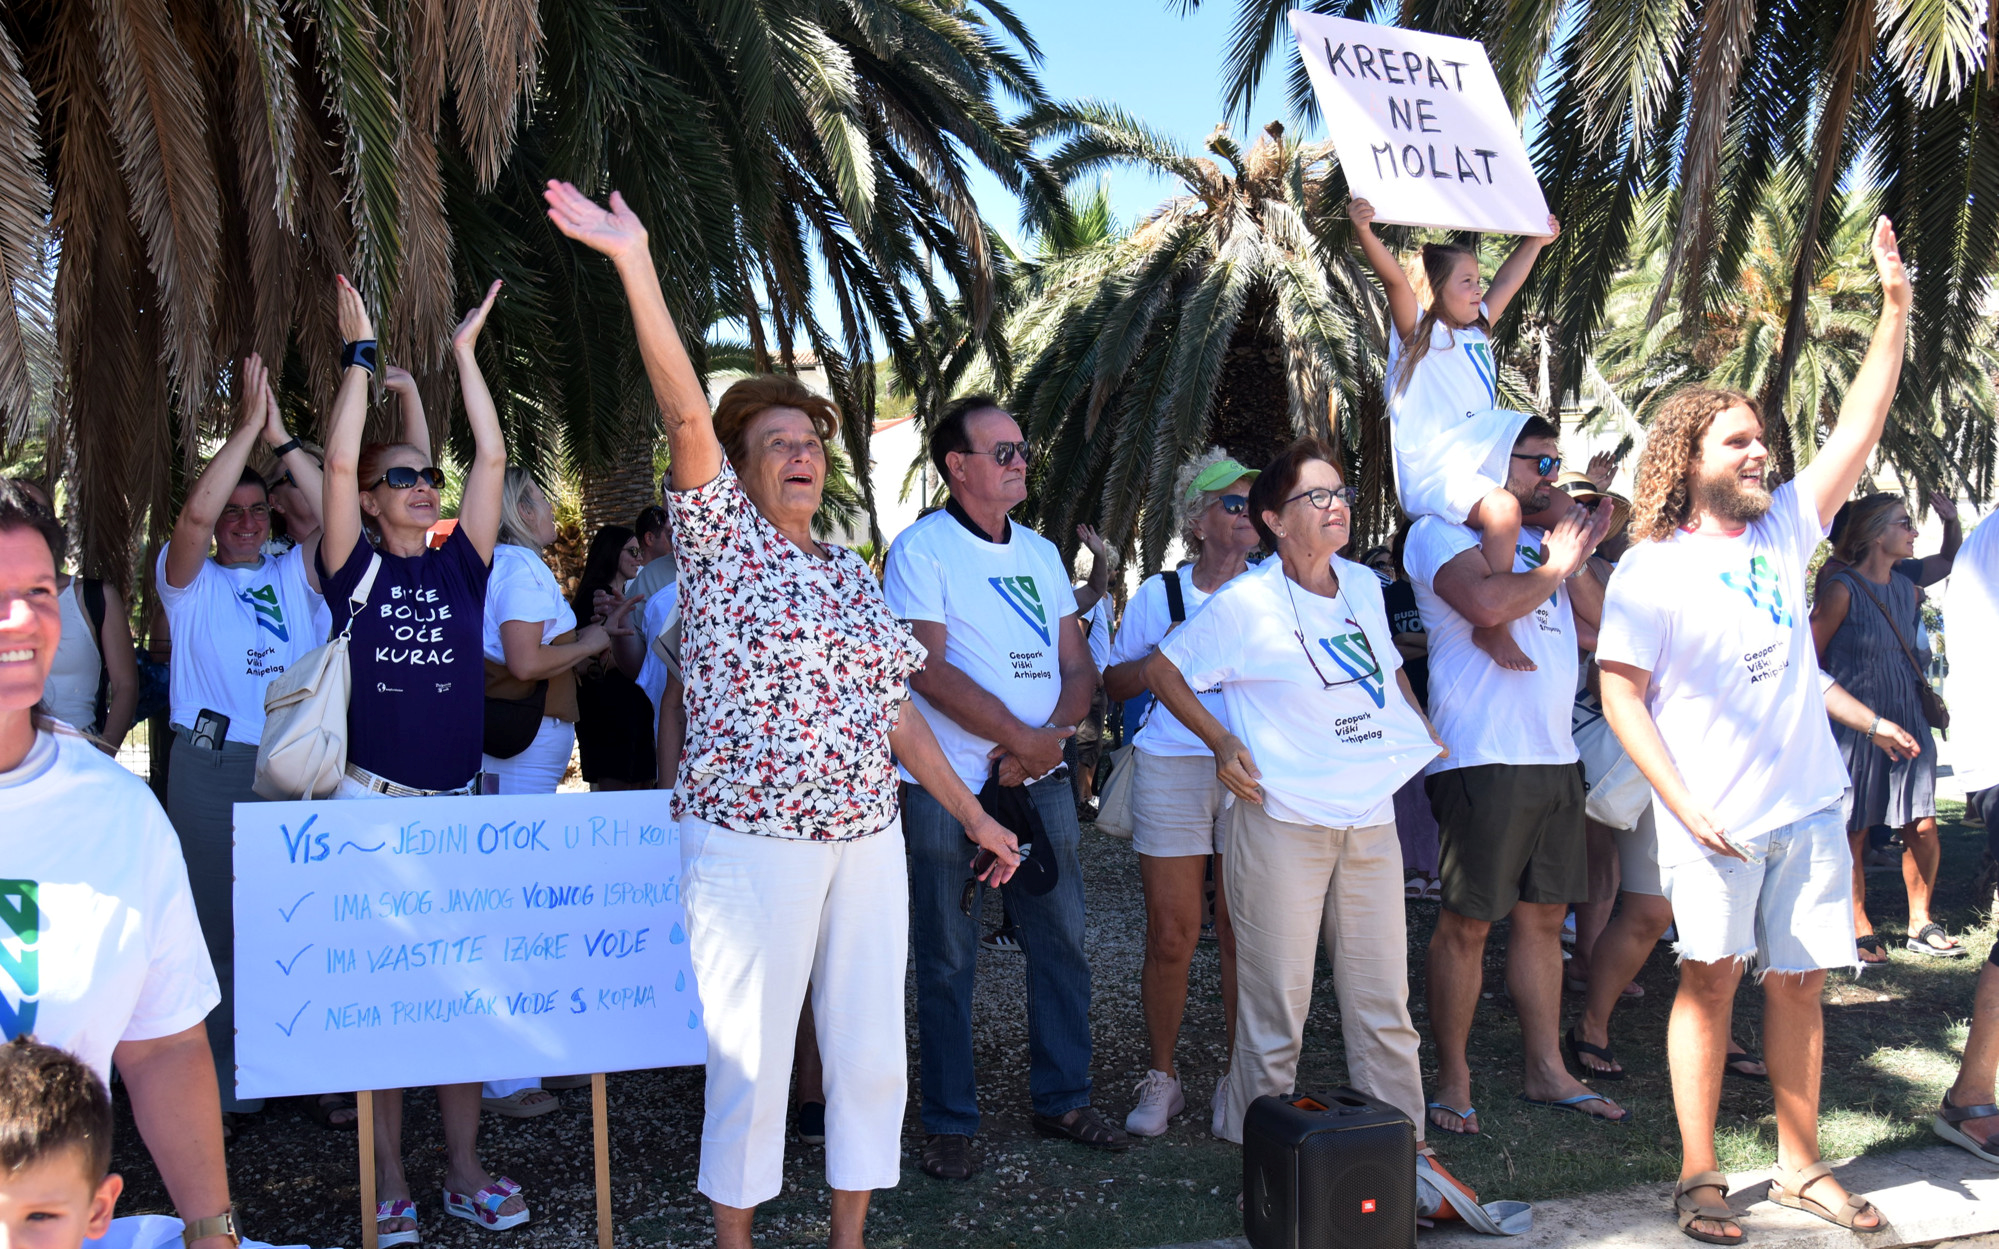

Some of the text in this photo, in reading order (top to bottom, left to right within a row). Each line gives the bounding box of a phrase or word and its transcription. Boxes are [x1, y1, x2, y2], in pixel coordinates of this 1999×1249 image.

[1324, 37, 1469, 93] KREPAT
[1388, 95, 1442, 133] NE
[1370, 141, 1499, 186] MOLAT
[380, 604, 452, 622] BOLJE
[375, 646, 455, 665] KURAC
[1009, 650, 1044, 661] Geopark
[1011, 661, 1033, 670] Viški
[1014, 670, 1052, 680] Arhipelag
[1334, 711, 1372, 727] Geopark
[1335, 724, 1359, 736] Viški
[1341, 730, 1383, 744] hipelag
[392, 822, 468, 856] JEDINI
[477, 819, 550, 855] OTOK
[565, 825, 580, 850] U
[589, 816, 630, 848] RH
[333, 875, 679, 922] IMA SVOG JAVNOG VODNOG ISPORUČI
[326, 927, 650, 975] IMA VLASTITE IZVORE VODE
[325, 984, 657, 1032] NEMA PRIKLJUČAK VODE S KOPNA
